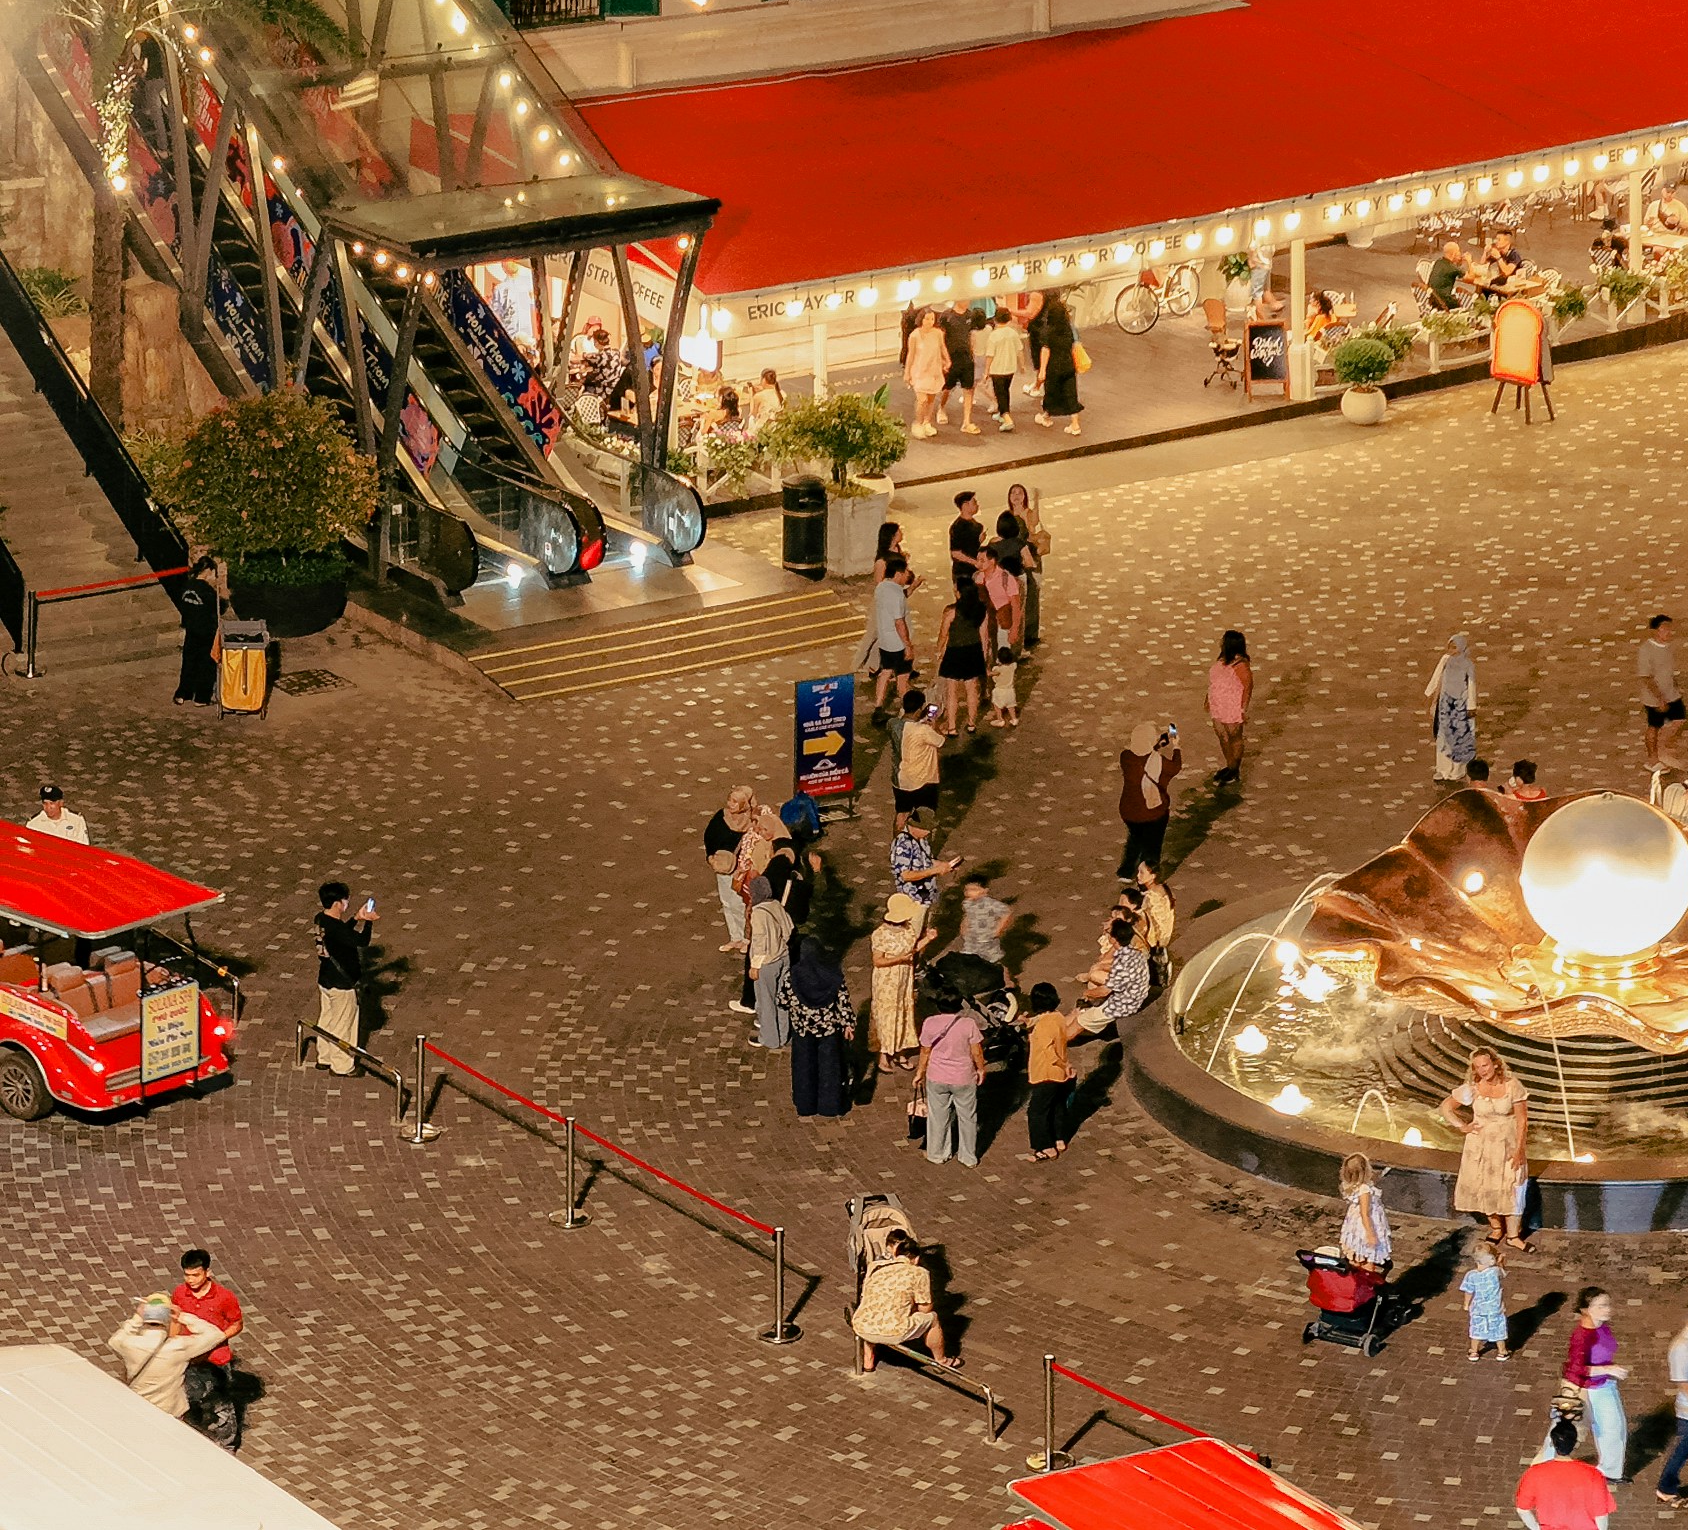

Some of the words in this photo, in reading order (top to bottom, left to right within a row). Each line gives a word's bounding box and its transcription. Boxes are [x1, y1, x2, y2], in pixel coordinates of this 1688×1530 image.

[586, 263, 616, 287] STRY
[632, 281, 665, 310] OFFEE
[748, 301, 785, 320] ERIC
[485, 334, 510, 375] THOM
